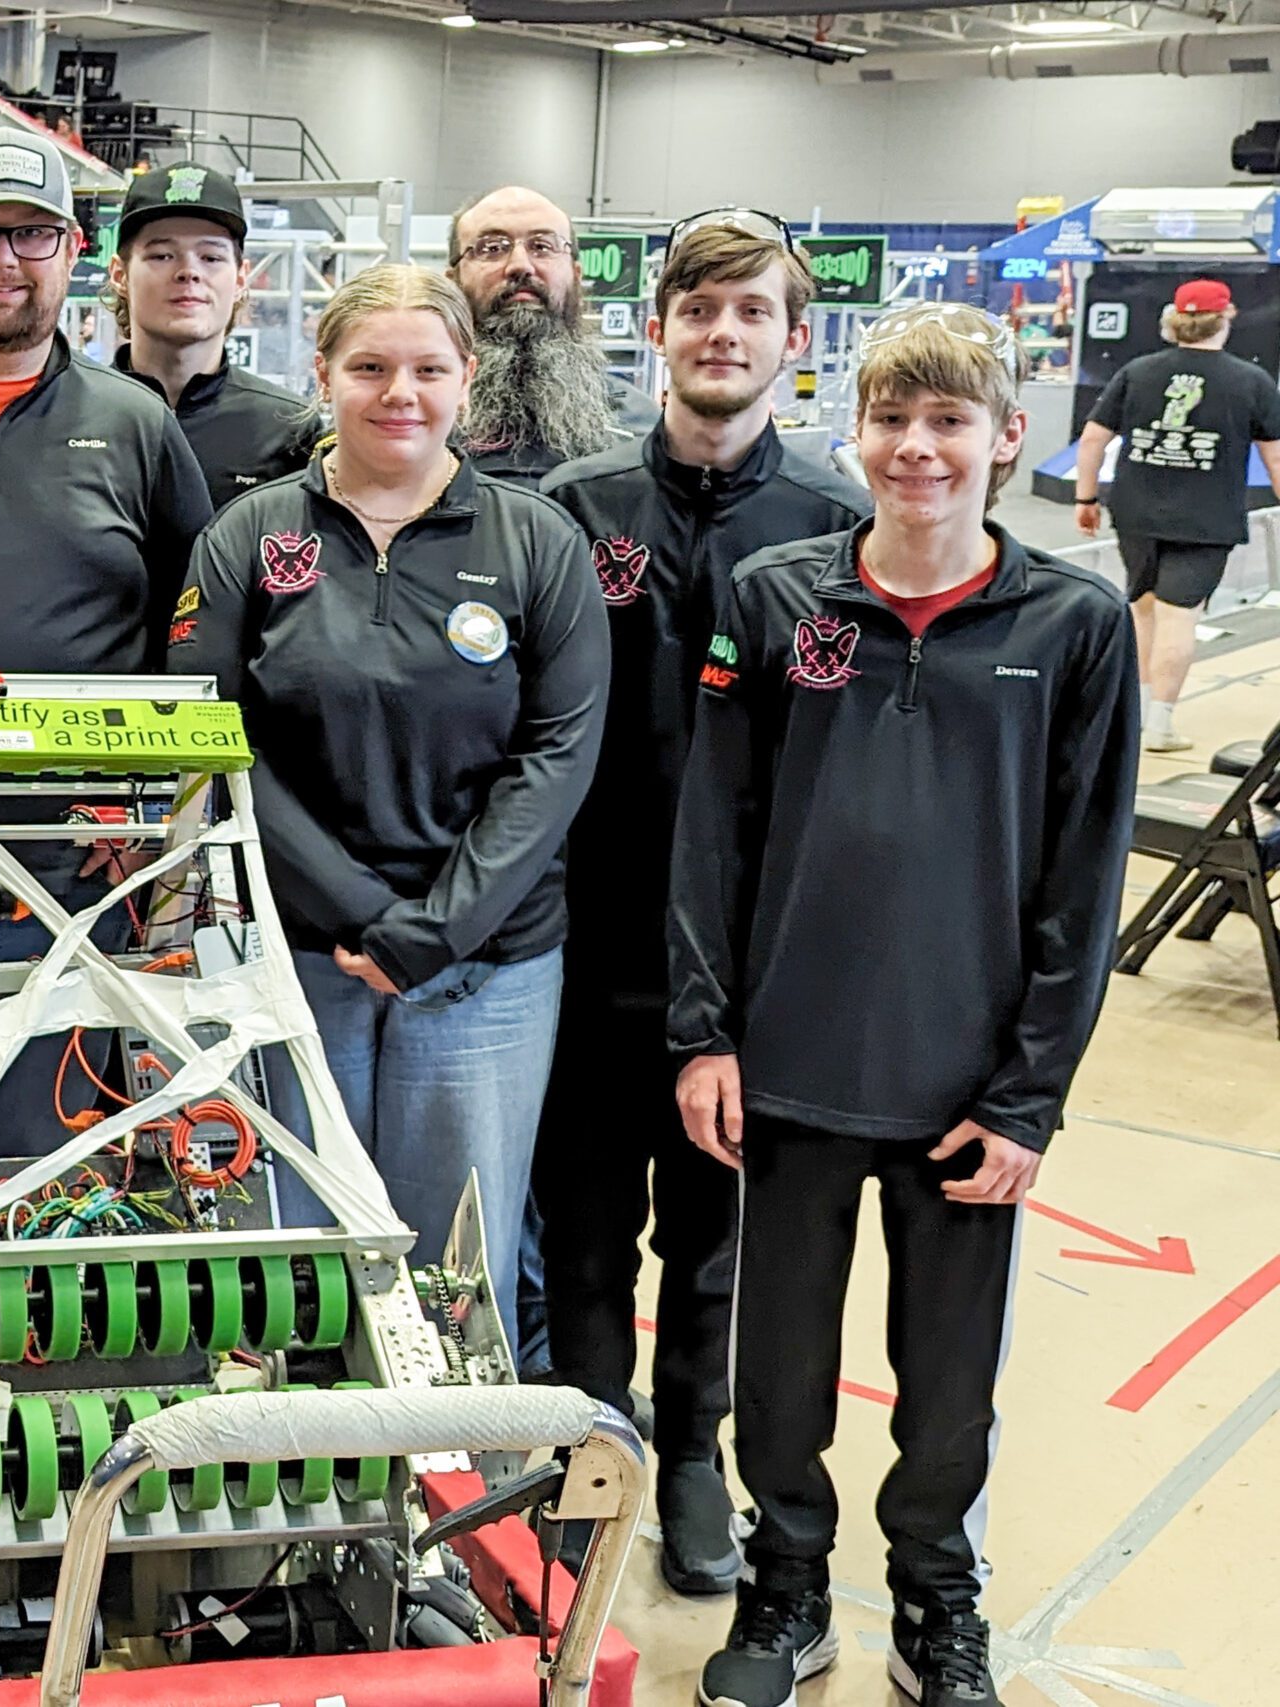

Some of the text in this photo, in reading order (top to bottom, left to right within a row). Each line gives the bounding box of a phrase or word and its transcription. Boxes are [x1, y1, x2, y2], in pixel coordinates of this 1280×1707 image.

[1002, 258, 1047, 278] 2024
[68, 439, 107, 448] Colville
[457, 571, 498, 586] Gentry
[995, 665, 1040, 677] Devers
[62, 709, 100, 726] as
[54, 726, 241, 751] a sprint car
